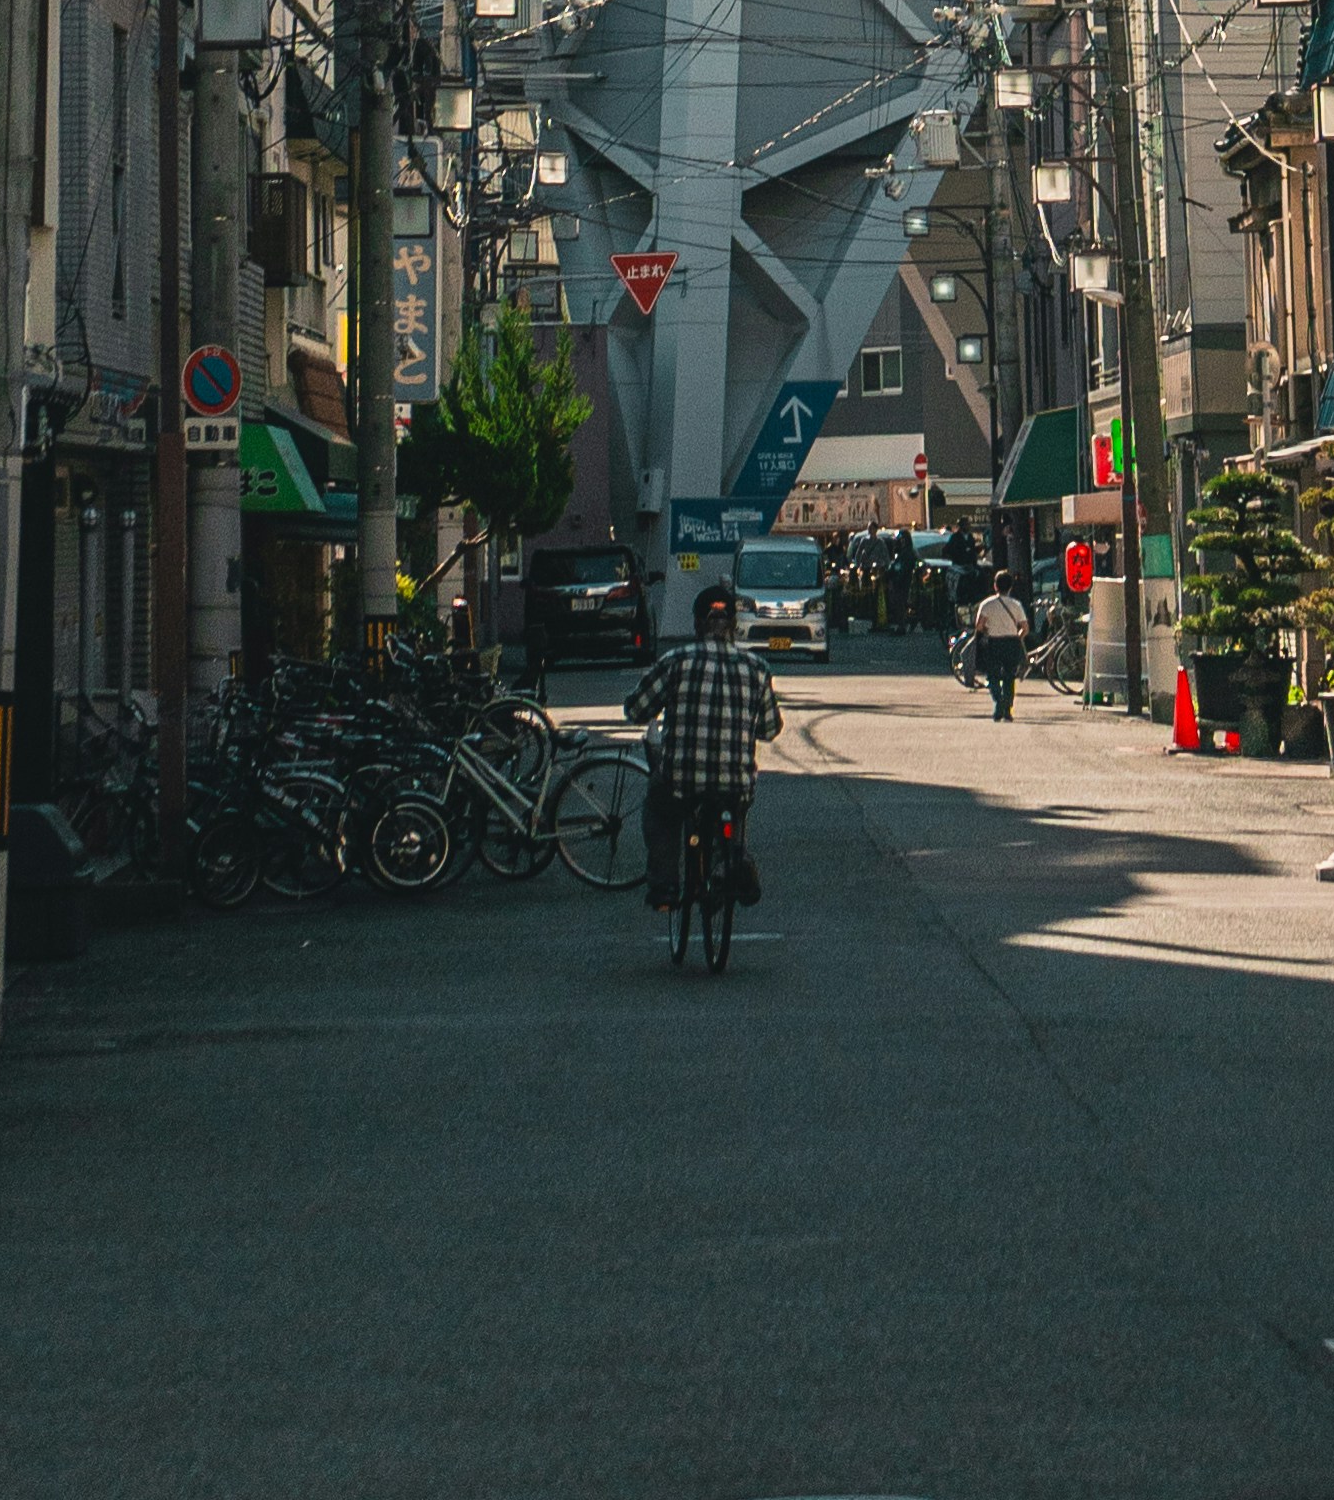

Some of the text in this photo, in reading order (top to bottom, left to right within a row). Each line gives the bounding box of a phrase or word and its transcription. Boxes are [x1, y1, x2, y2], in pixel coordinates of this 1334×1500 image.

[626, 263, 665, 280] 止まれ
[187, 424, 237, 443] 自動車
